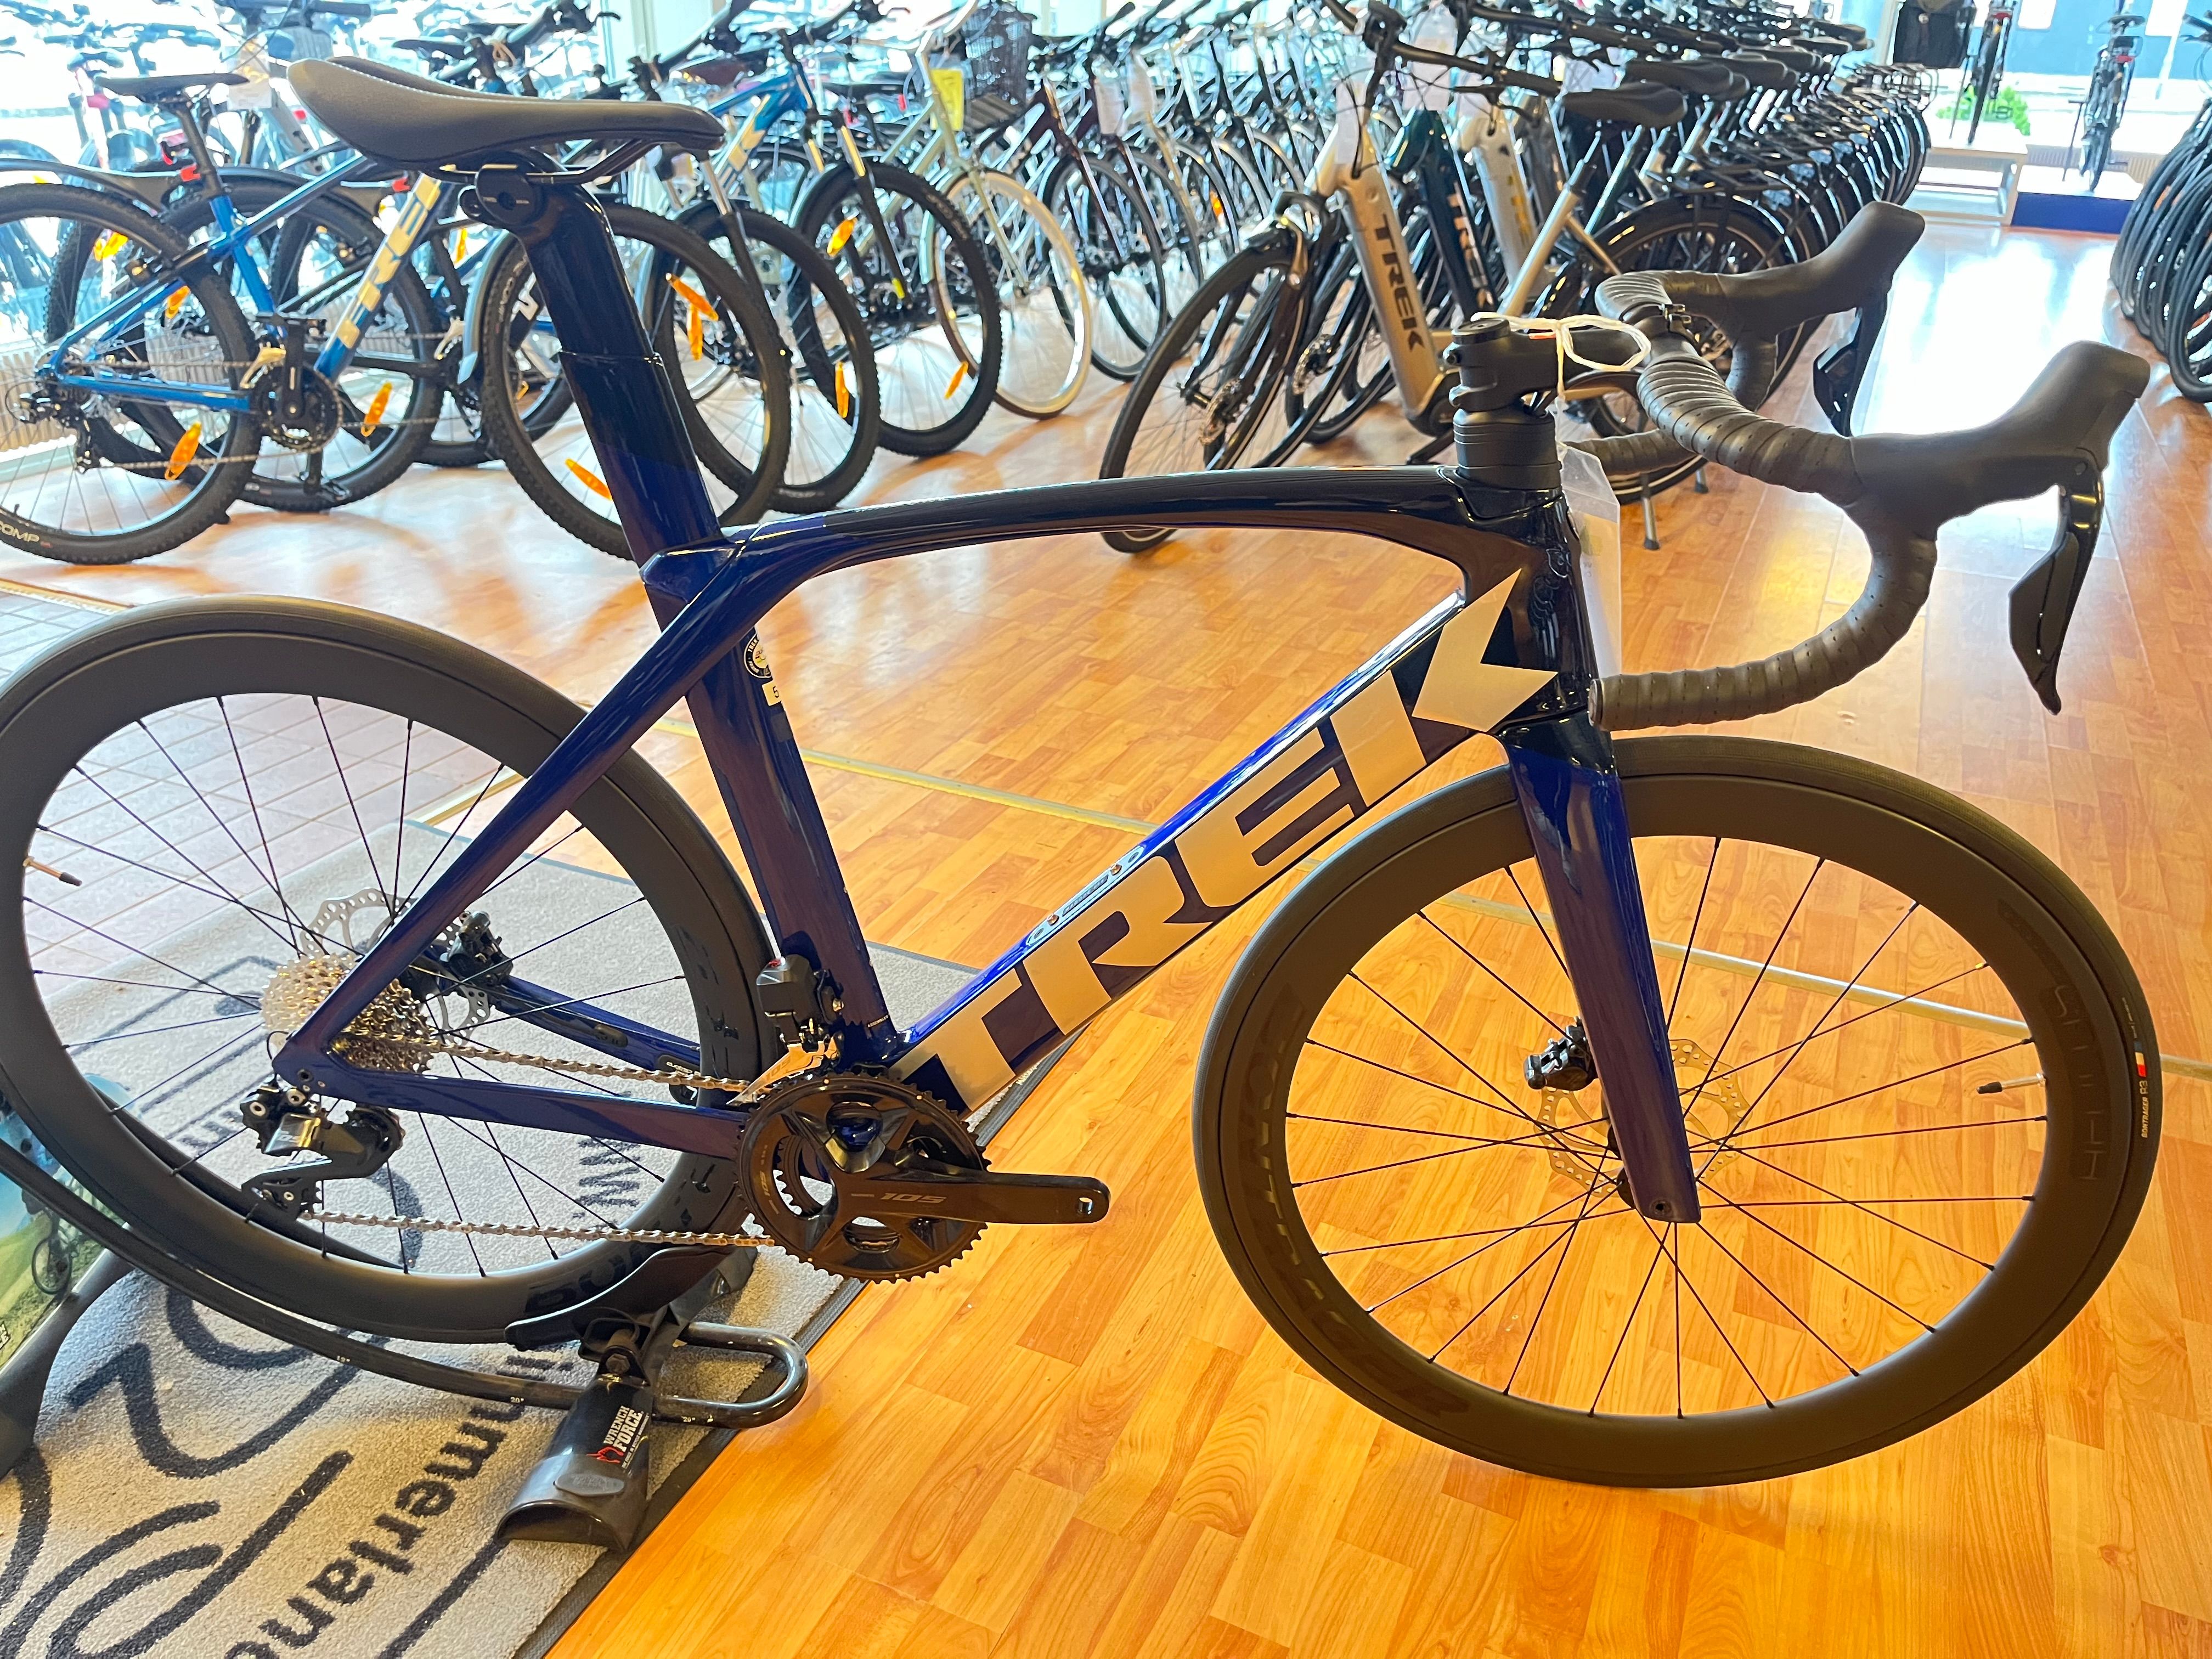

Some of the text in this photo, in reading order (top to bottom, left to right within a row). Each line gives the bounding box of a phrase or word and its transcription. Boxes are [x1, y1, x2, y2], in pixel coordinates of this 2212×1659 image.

[1374, 213, 1425, 351] TREK
[890, 568, 1558, 1110] TREK
[2139, 1080, 2148, 1095] R3
[881, 1192, 947, 1204] 105
[603, 1405, 630, 1445] WRENCH
